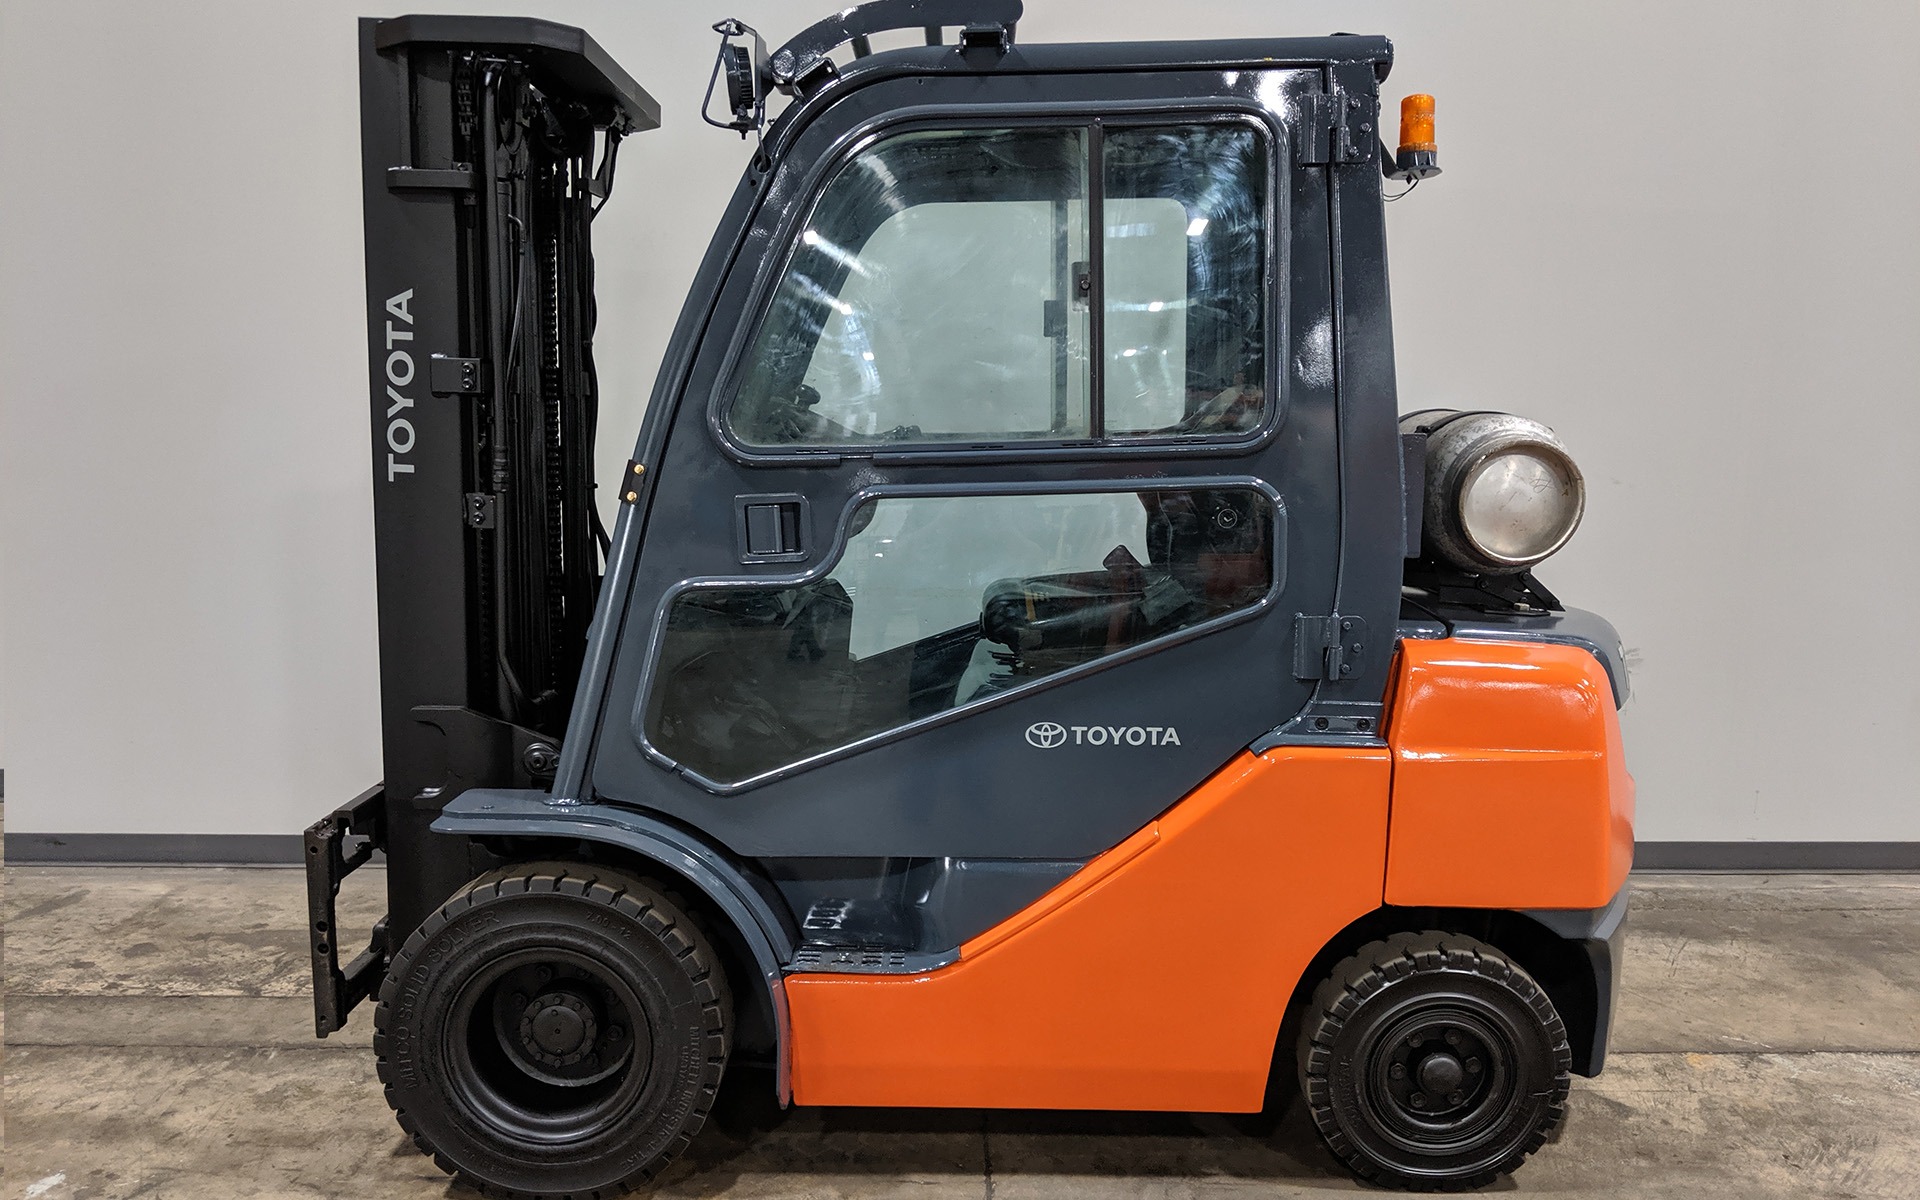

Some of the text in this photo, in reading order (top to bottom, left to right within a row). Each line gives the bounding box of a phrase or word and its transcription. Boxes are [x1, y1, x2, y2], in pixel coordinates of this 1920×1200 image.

[386, 288, 416, 482] TOYOTA
[1071, 726, 1181, 746] TOYOTA
[400, 964, 431, 1020] SOLID
[428, 910, 500, 963] SOLVER
